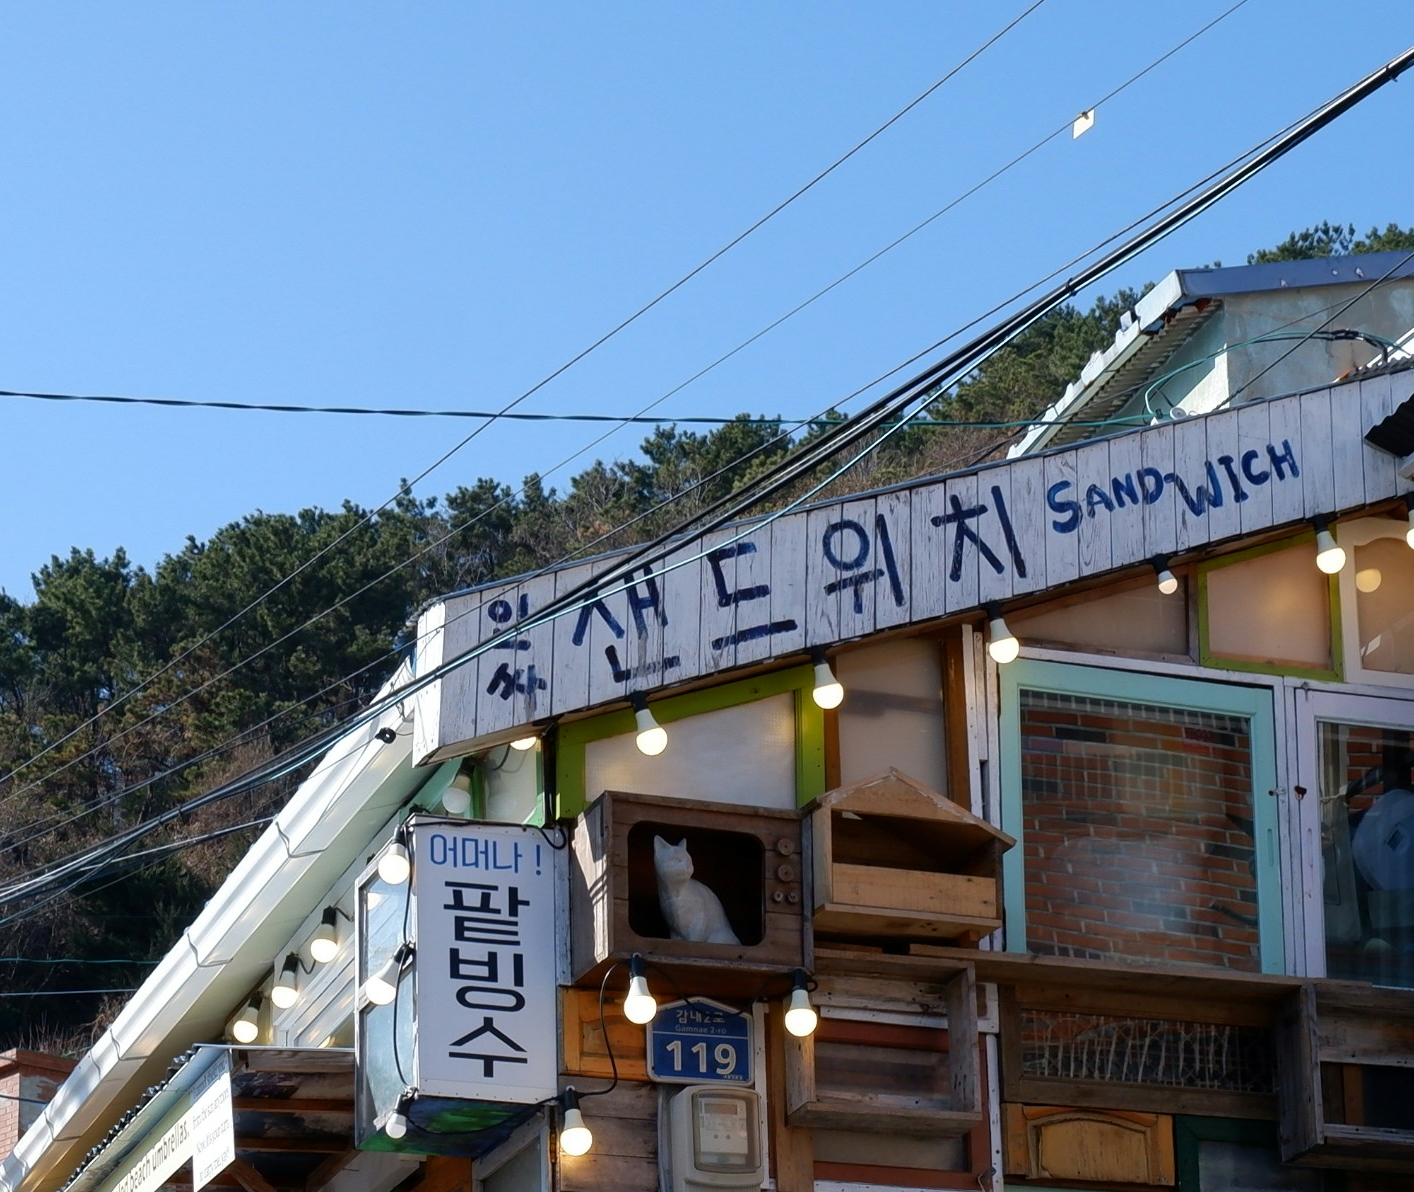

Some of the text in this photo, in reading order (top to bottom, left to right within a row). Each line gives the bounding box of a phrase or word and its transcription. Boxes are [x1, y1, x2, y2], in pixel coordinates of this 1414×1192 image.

[1046, 438, 1300, 535] SANDWICH
[443, 881, 530, 1078] 팥빙수
[666, 1040, 737, 1075] 119
